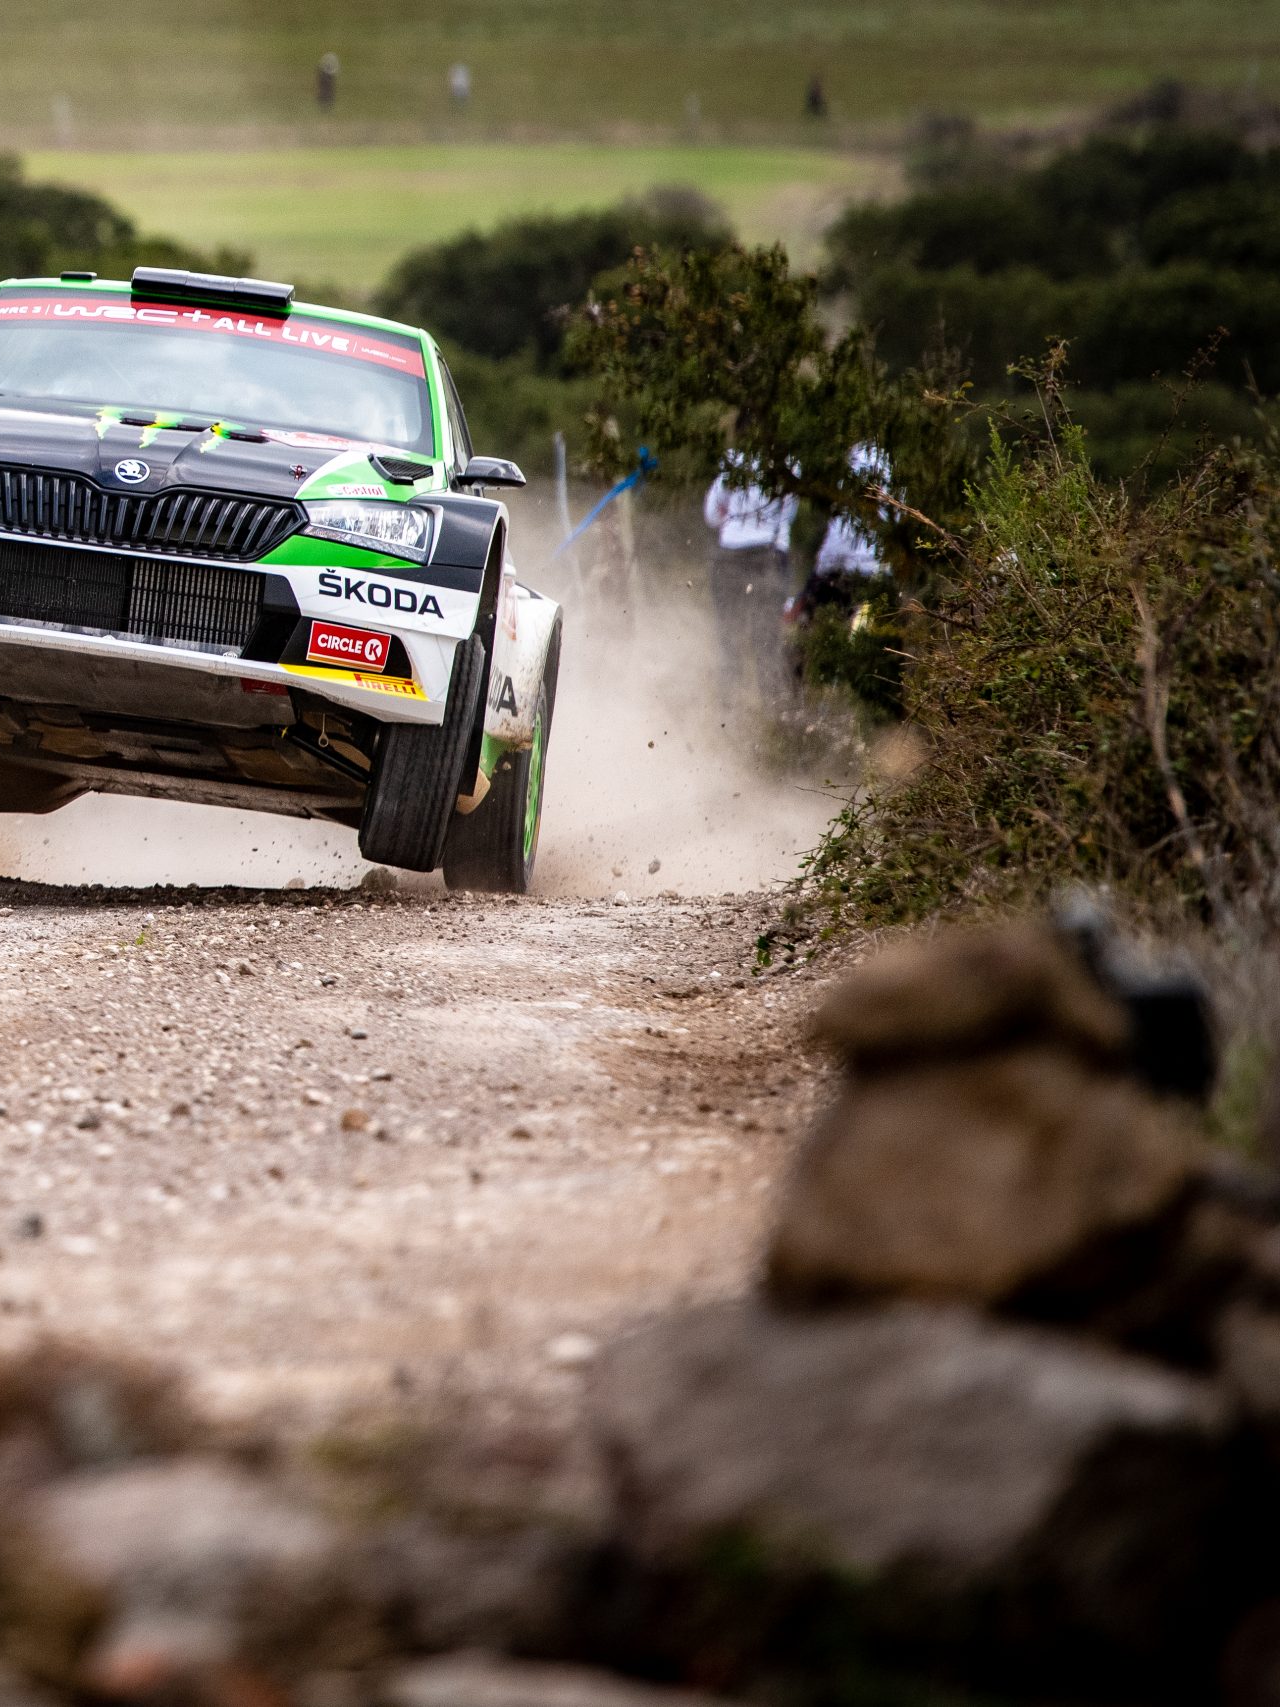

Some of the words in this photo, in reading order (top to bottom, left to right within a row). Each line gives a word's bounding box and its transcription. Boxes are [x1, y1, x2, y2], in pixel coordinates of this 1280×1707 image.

[213, 317, 272, 336] ALL
[282, 327, 350, 352] LIVE
[342, 486, 383, 495] Castrol
[318, 568, 445, 619] ŠKODA
[317, 633, 363, 654] CIRCLE
[367, 641, 382, 660] K
[353, 673, 417, 695] PIRELLI
